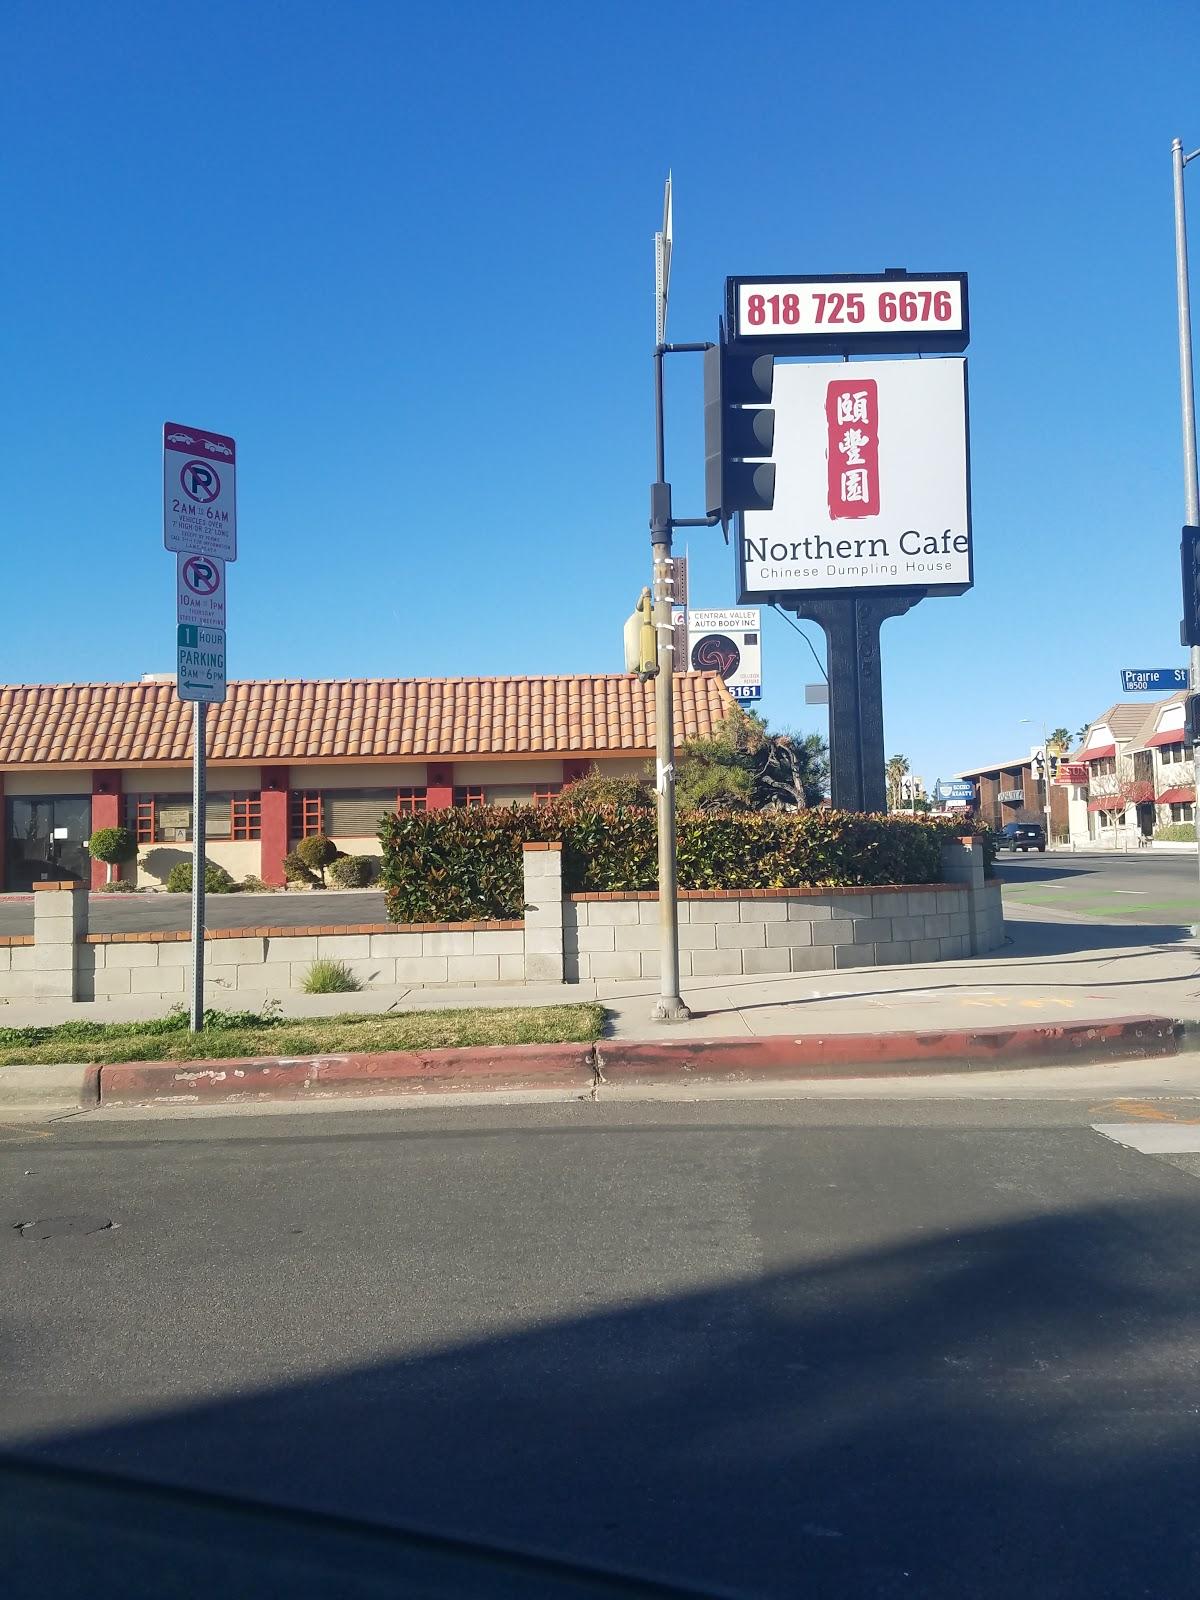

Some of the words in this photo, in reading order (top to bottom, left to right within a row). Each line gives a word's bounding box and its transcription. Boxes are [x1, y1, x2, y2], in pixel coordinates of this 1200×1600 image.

[748, 293, 800, 326] 818
[812, 292, 865, 324] 725
[878, 290, 952, 322] 6676
[837, 390, 870, 504] 頤豐園
[173, 499, 196, 515] 2AM
[207, 507, 229, 521] 6AM
[178, 521, 193, 531] HIGH
[179, 515, 206, 526] VEHICLES
[208, 519, 223, 529] OVER
[744, 535, 890, 563] Northern
[899, 528, 969, 556] Cafe
[760, 565, 818, 579] Chinese
[827, 562, 898, 577] Dumpling
[906, 560, 953, 572] House
[180, 594, 201, 608] 10AM
[210, 599, 223, 611] 1PM
[741, 619, 756, 627] INC
[199, 629, 223, 645] HOUR
[180, 650, 224, 669] PARKING
[180, 666, 198, 679] 8AM
[206, 668, 224, 681] 6PM
[1125, 671, 1160, 682] Prairie
[1174, 669, 1186, 681] St
[1126, 682, 1148, 690] 18500
